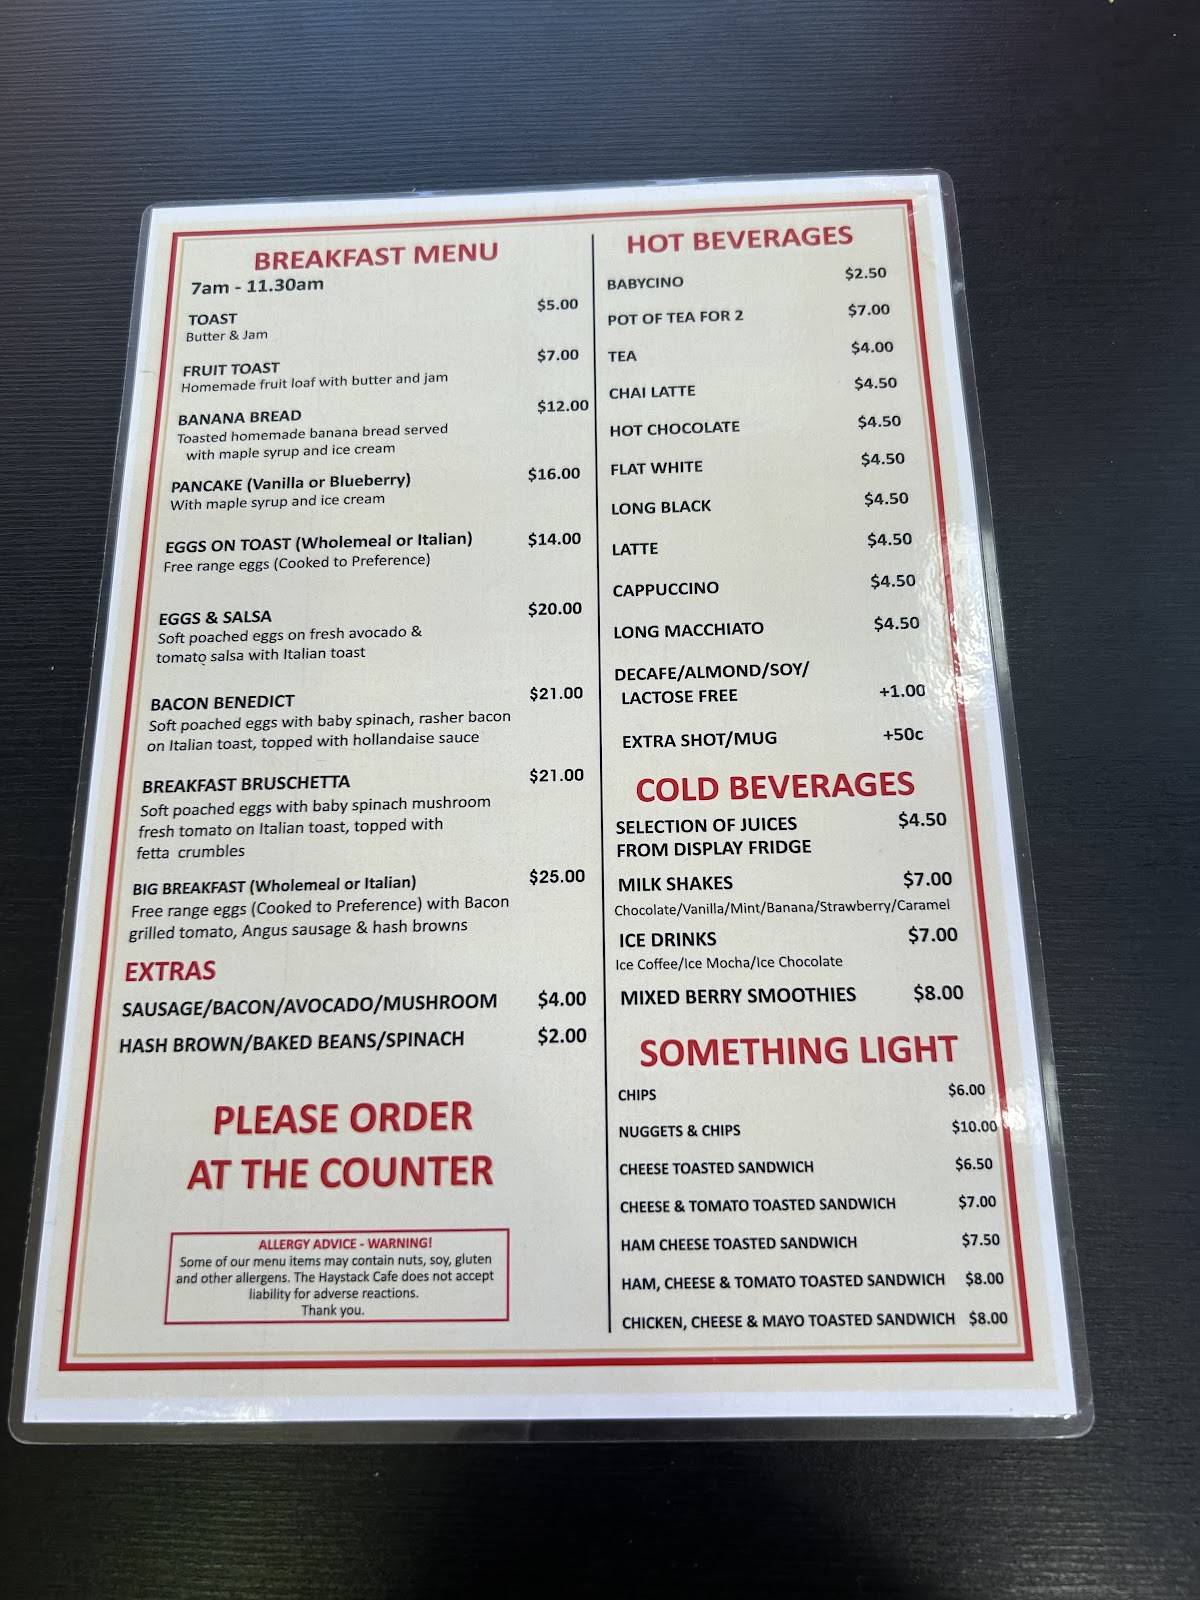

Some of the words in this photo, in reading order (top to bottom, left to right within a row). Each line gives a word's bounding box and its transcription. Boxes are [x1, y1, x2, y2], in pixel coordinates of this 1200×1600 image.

[627, 232, 685, 255] HOT
[693, 225, 854, 251] BEVERAGES
[254, 246, 407, 271] BREAKFAST
[414, 241, 498, 265] MENU
[845, 266, 887, 282] $2.50
[191, 281, 230, 295] 7am
[247, 277, 324, 293] 11.30am
[607, 276, 684, 291] BABYCINO
[537, 298, 579, 313] $5.00
[848, 303, 891, 319] $7.00
[187, 312, 239, 326] TOAST
[607, 313, 639, 327] POT
[642, 312, 663, 325] OF
[666, 311, 696, 324] TEA
[699, 310, 731, 323] FOR
[734, 309, 744, 322] 2
[186, 331, 226, 343] Butter
[229, 329, 240, 341] &
[242, 329, 268, 341] Jam
[537, 348, 580, 364] $7.00
[607, 350, 638, 363] TEA
[851, 340, 894, 356] $4.00
[182, 364, 228, 378] FRUIT
[230, 361, 281, 376] TOAST
[608, 386, 646, 400] CHAI
[651, 384, 696, 398] LATTE
[854, 376, 898, 392] $4.50
[537, 399, 589, 415] $12.00
[178, 411, 246, 427] BANANA
[249, 409, 302, 424] BREAD
[186, 448, 215, 461] with
[218, 447, 260, 462] maple
[263, 448, 300, 460] syrup
[303, 444, 328, 457] and
[332, 444, 351, 456] ice
[354, 444, 396, 455] cream
[171, 478, 243, 494] PANCAKE
[246, 476, 304, 493] (Vanilla
[308, 478, 326, 489] or
[329, 472, 411, 489] Blueberry)
[165, 540, 207, 554] EGGS
[210, 539, 236, 553] ON
[239, 537, 292, 552] TOAST
[295, 533, 392, 553] (Wholemeal
[395, 536, 414, 547] or
[417, 531, 473, 548] Italian)
[612, 542, 659, 557] LATTE
[612, 581, 720, 598] CAPPUCCINO
[870, 573, 916, 591] $4.50
[528, 601, 583, 619] $20.00
[613, 625, 660, 640] LONG
[664, 621, 765, 638] MACCHIATO
[614, 660, 810, 683] DECAFE/ALMOND/SOY/
[529, 686, 584, 703] $21.00
[879, 683, 926, 698] +1.00
[150, 696, 209, 712] BACON
[213, 694, 296, 710] BENEDICT
[148, 718, 178, 732] Soft
[180, 716, 242, 734] poached
[245, 719, 278, 732] eggs
[281, 714, 313, 728] with
[317, 714, 353, 729] baby
[355, 712, 415, 729] spinach,
[419, 711, 465, 724] rasher
[468, 710, 511, 723] bacon
[622, 734, 677, 749] EXTRA
[680, 730, 777, 749] SHOT/MUG
[883, 727, 924, 742] +50c
[529, 767, 585, 785] $21.00
[636, 776, 720, 803] COLD
[729, 770, 916, 801] BEVERAGES
[615, 818, 708, 835] SELECTION
[712, 818, 736, 833] OF
[740, 816, 798, 832] JUICES
[898, 810, 947, 830] $4.50
[136, 846, 170, 860] fetta
[177, 843, 245, 859] crumbles
[529, 868, 586, 886] $25.00
[903, 869, 953, 889] $7.00
[614, 898, 951, 917] Chocolate/Vanilla/Mint/Banana/Strawberry/Caramel
[127, 925, 175, 944] grilled
[178, 925, 237, 940] tomato,
[241, 924, 288, 940] Angus
[291, 924, 352, 938] sausage
[356, 920, 369, 934] &
[372, 919, 408, 934] hash
[412, 918, 468, 933] browns
[619, 932, 646, 949] ICE
[651, 931, 717, 948] DRINKS
[908, 925, 958, 945] $7.00
[124, 960, 217, 982] EXTRAS
[615, 959, 634, 971] Ice
[637, 956, 703, 972] Coffee/Ice
[706, 955, 775, 971] Mocha/Ice
[778, 955, 843, 968] Chocolate
[538, 989, 587, 1010] $4.00
[620, 989, 680, 1006] MIXED
[685, 988, 743, 1005] BERRY
[747, 986, 857, 1004] SMOOTHIES
[913, 983, 964, 1004] $8.00
[121, 993, 497, 1019] SAUSAGE/BACON/AVOCADO/MUSHROOM
[119, 1037, 168, 1054] HASH
[172, 1033, 313, 1055] BROWN/BAKED
[318, 1030, 465, 1051] BEANS/SPINACH
[537, 1026, 587, 1047] $2.00
[640, 1036, 849, 1068] SOMETHING
[859, 1034, 959, 1064] LIGHT
[617, 1088, 657, 1102] CHIPS
[948, 1082, 986, 1098] $6.00
[213, 1103, 339, 1136] PLEASE
[349, 1100, 473, 1134] ORDER
[952, 1119, 999, 1135] $10.00
[618, 1125, 684, 1138] NUGGETS
[686, 1124, 699, 1137] &
[701, 1124, 741, 1137] CHIPS
[186, 1159, 233, 1191] AT
[240, 1158, 309, 1190] THE
[319, 1154, 494, 1189] COUNTER
[619, 1162, 669, 1176] CHEESE
[672, 1161, 735, 1175] TOASTED
[737, 1160, 814, 1174] SANDWICH
[955, 1156, 993, 1173] $6.50
[258, 1238, 311, 1251] ALLERGY
[312, 1238, 357, 1250] ADVICE
[367, 1236, 433, 1250] WARNING!
[179, 1256, 213, 1268] Some
[215, 1255, 229, 1268] of
[230, 1258, 251, 1267] our
[253, 1257, 286, 1267] menu
[289, 1255, 322, 1268] items
[324, 1257, 349, 1269] may
[351, 1254, 395, 1266] contain
[397, 1255, 427, 1267] nuts,
[429, 1256, 452, 1268] soy,
[454, 1253, 492, 1268] gluten
[248, 1287, 292, 1302] liability
[293, 1287, 311, 1300] for
[313, 1287, 359, 1300] adverse
[361, 1288, 419, 1299] reactions.
[301, 1303, 337, 1317] Thank
[339, 1306, 365, 1319] you.
[968, 1310, 1009, 1327] $8.00
[621, 1315, 687, 1332] CHICKEN,
[690, 1315, 743, 1329] CHEESE
[746, 1314, 759, 1328] &
[762, 1314, 805, 1328] MAYO
[808, 1313, 873, 1328] TOASTED
[876, 1312, 956, 1326] SANDWICH
